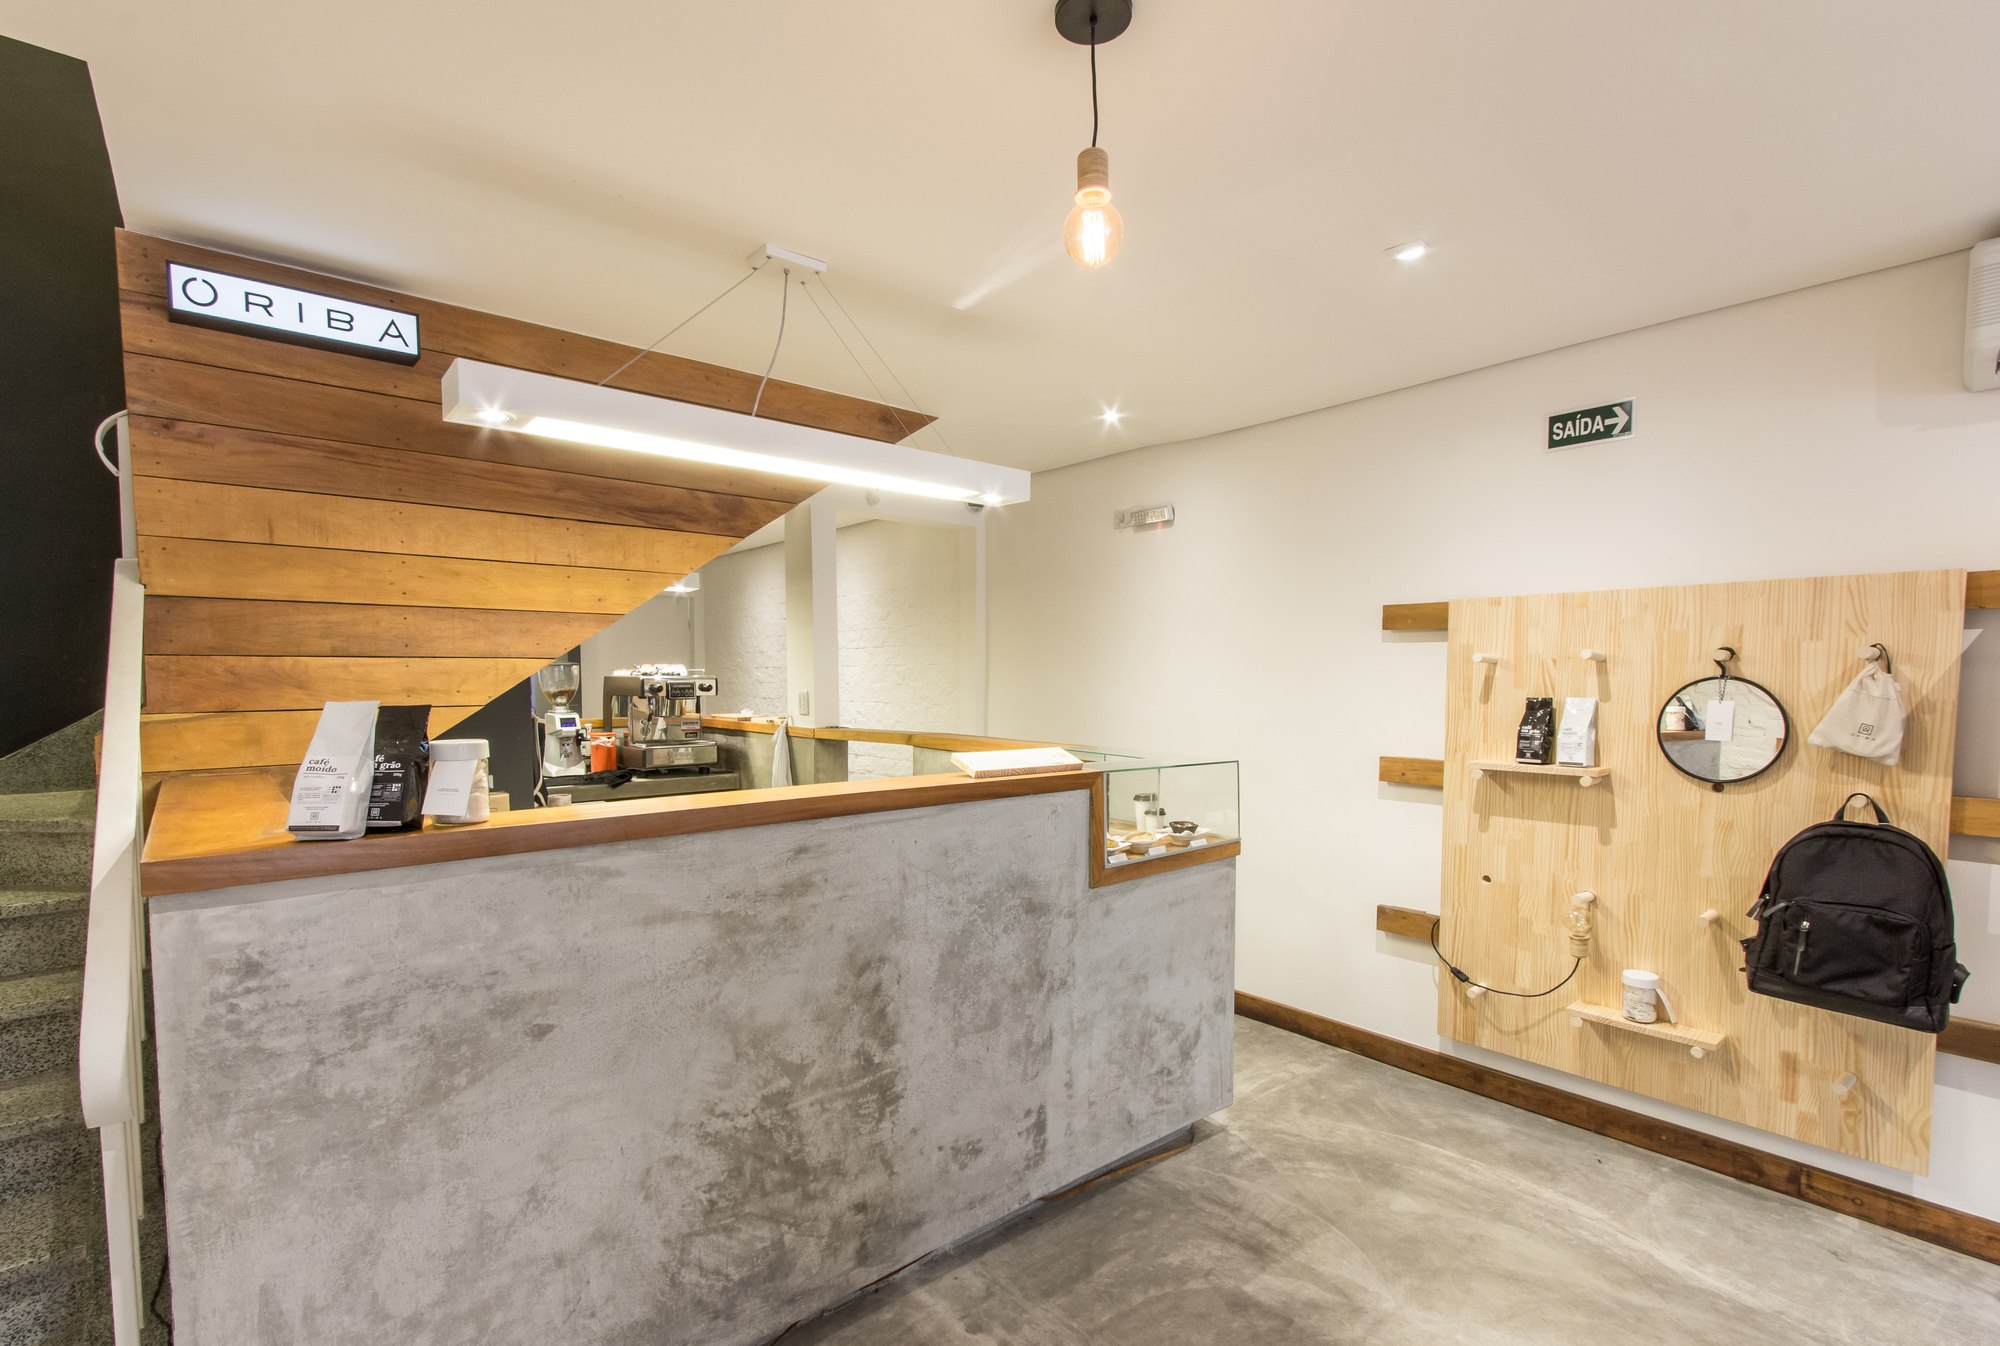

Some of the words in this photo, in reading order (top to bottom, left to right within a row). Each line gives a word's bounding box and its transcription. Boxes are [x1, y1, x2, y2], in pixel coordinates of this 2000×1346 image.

[181, 277, 410, 348] ORIBA
[1552, 413, 1605, 441] SAÍDA
[308, 758, 330, 767] café
[379, 761, 401, 771] grão
[305, 763, 338, 773] moído
